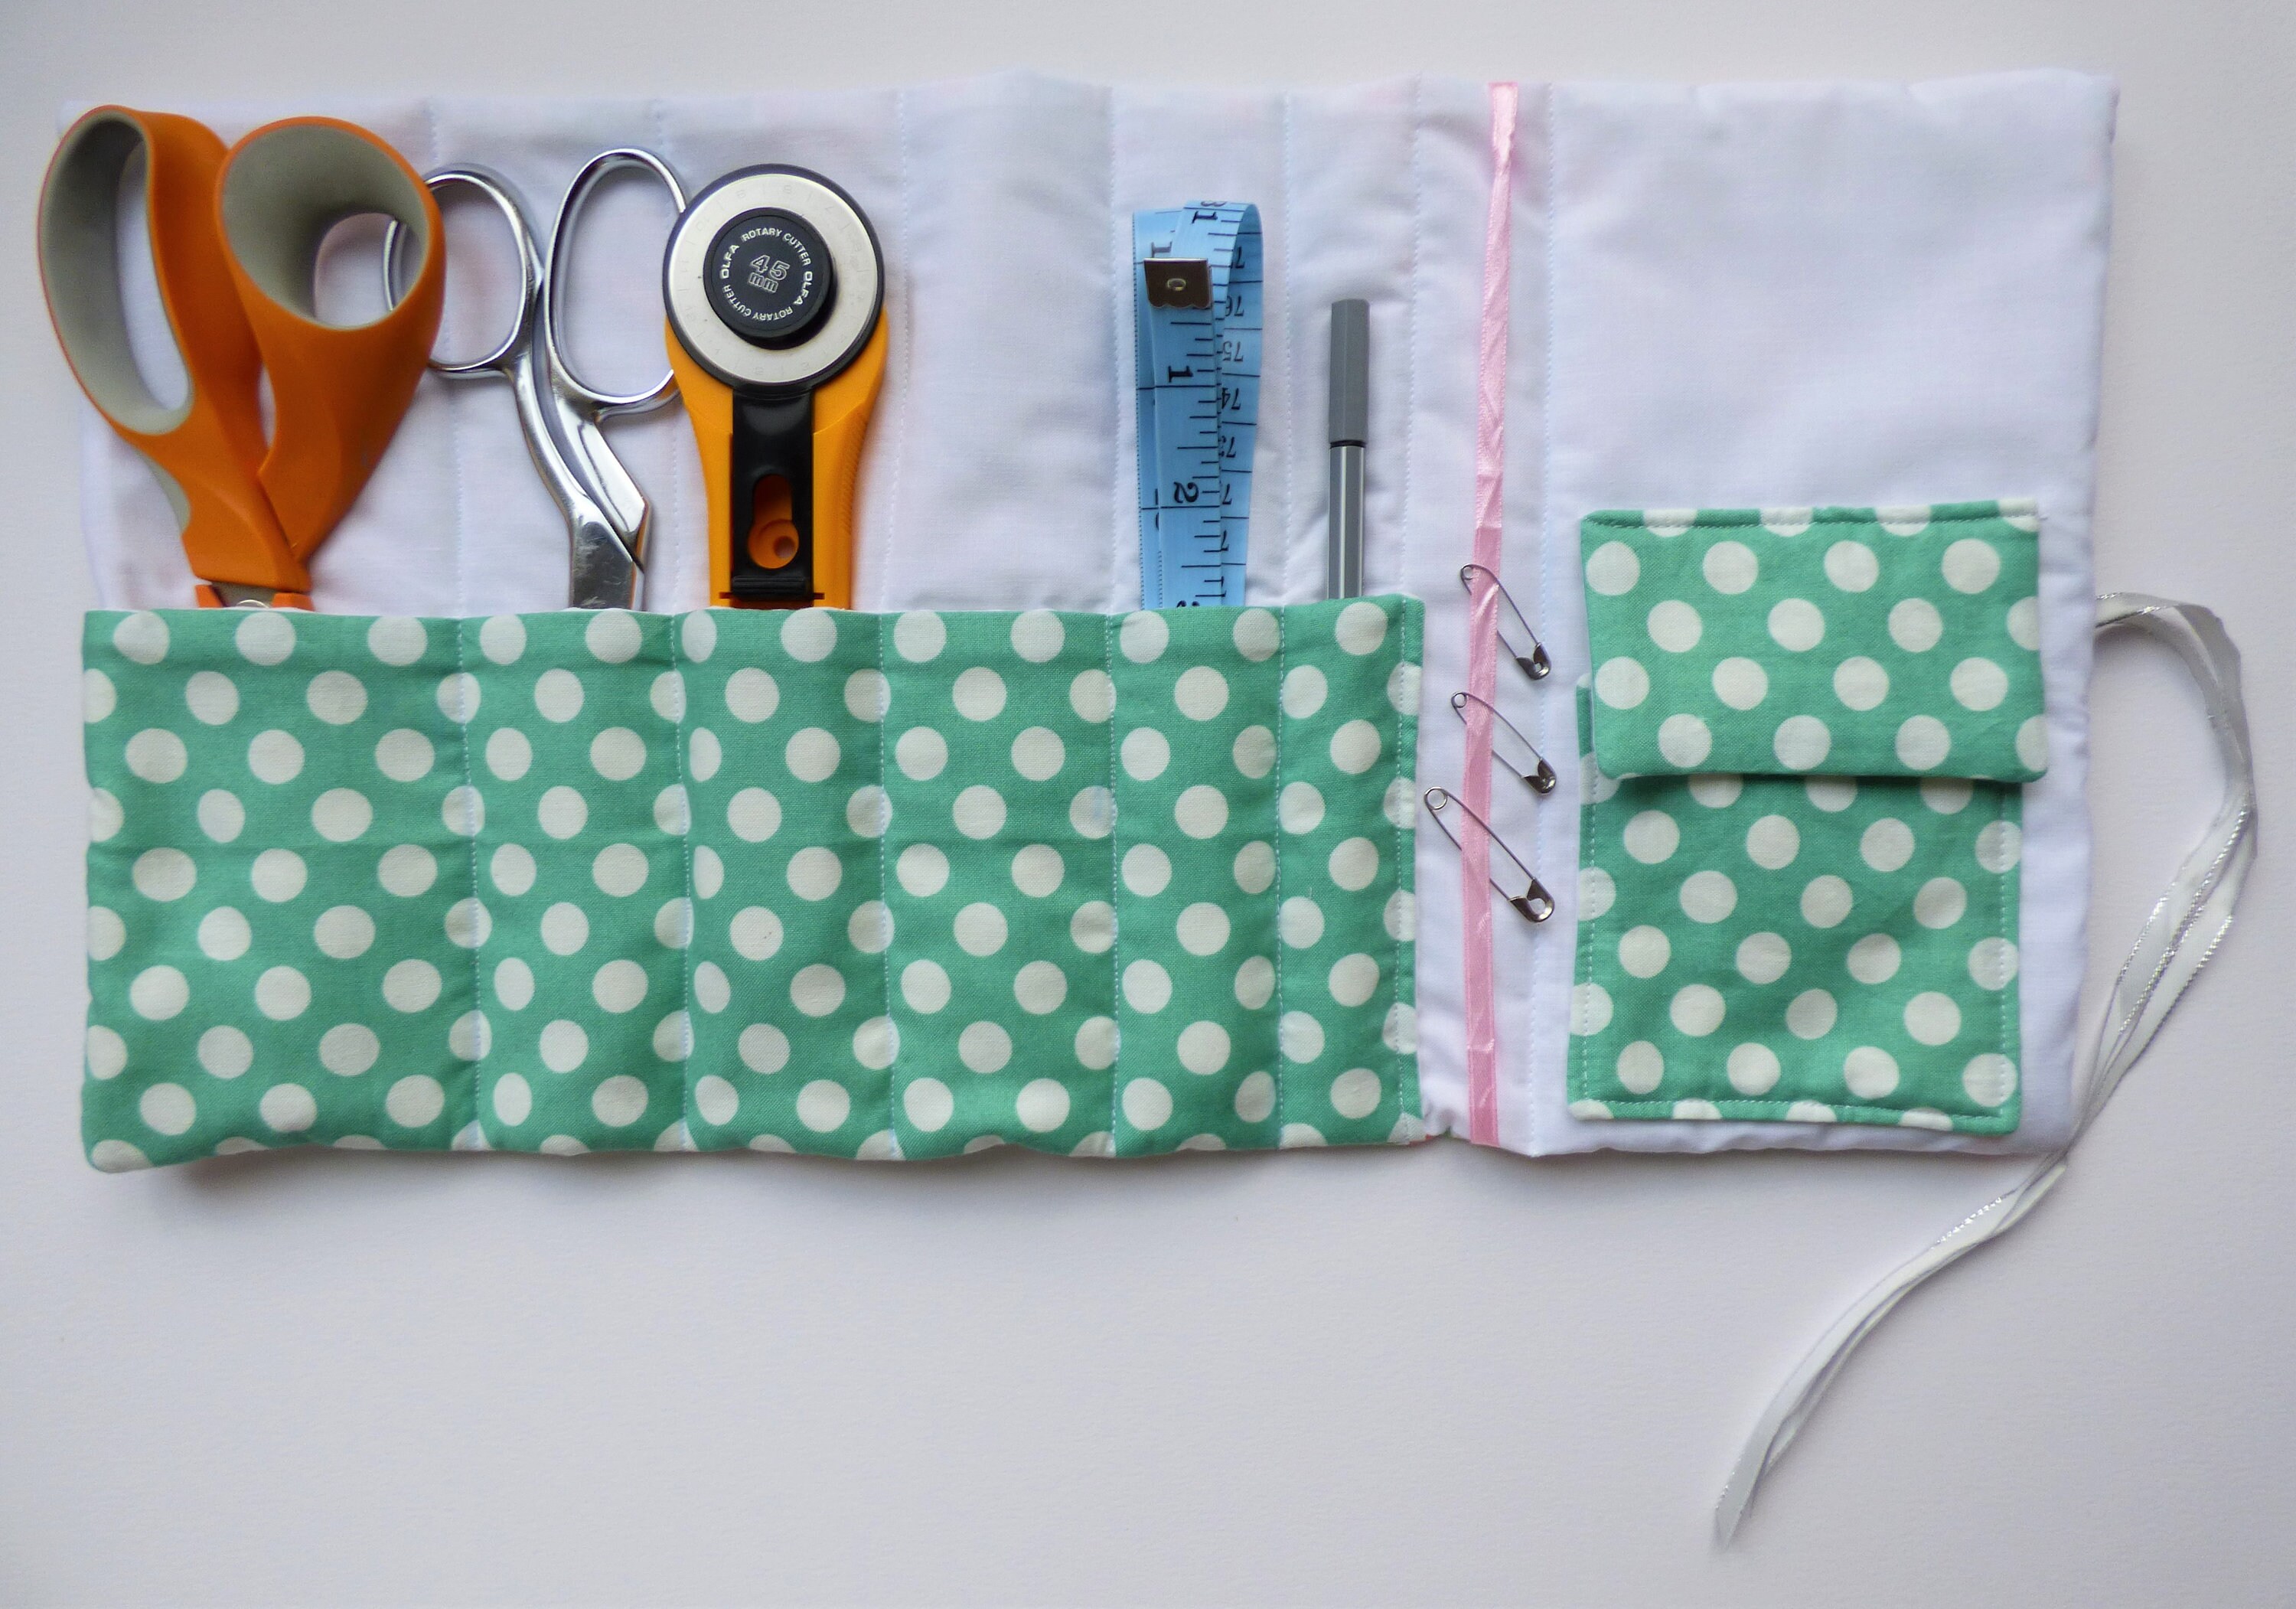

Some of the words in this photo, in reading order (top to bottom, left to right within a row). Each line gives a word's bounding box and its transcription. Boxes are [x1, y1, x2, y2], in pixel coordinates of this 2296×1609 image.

[719, 243, 740, 279] OLFA
[741, 227, 782, 243] ROTARY
[782, 232, 811, 267] CUTTER
[749, 255, 791, 282] 45
[748, 273, 778, 293] mm
[796, 271, 814, 305] OLFA
[722, 285, 753, 318] CUTTER
[752, 306, 794, 322] ROTARY
[1222, 341, 1244, 362] 75
[1167, 365, 1194, 383] 1
[1221, 387, 1241, 410] 74
[1173, 481, 1199, 503] 2
